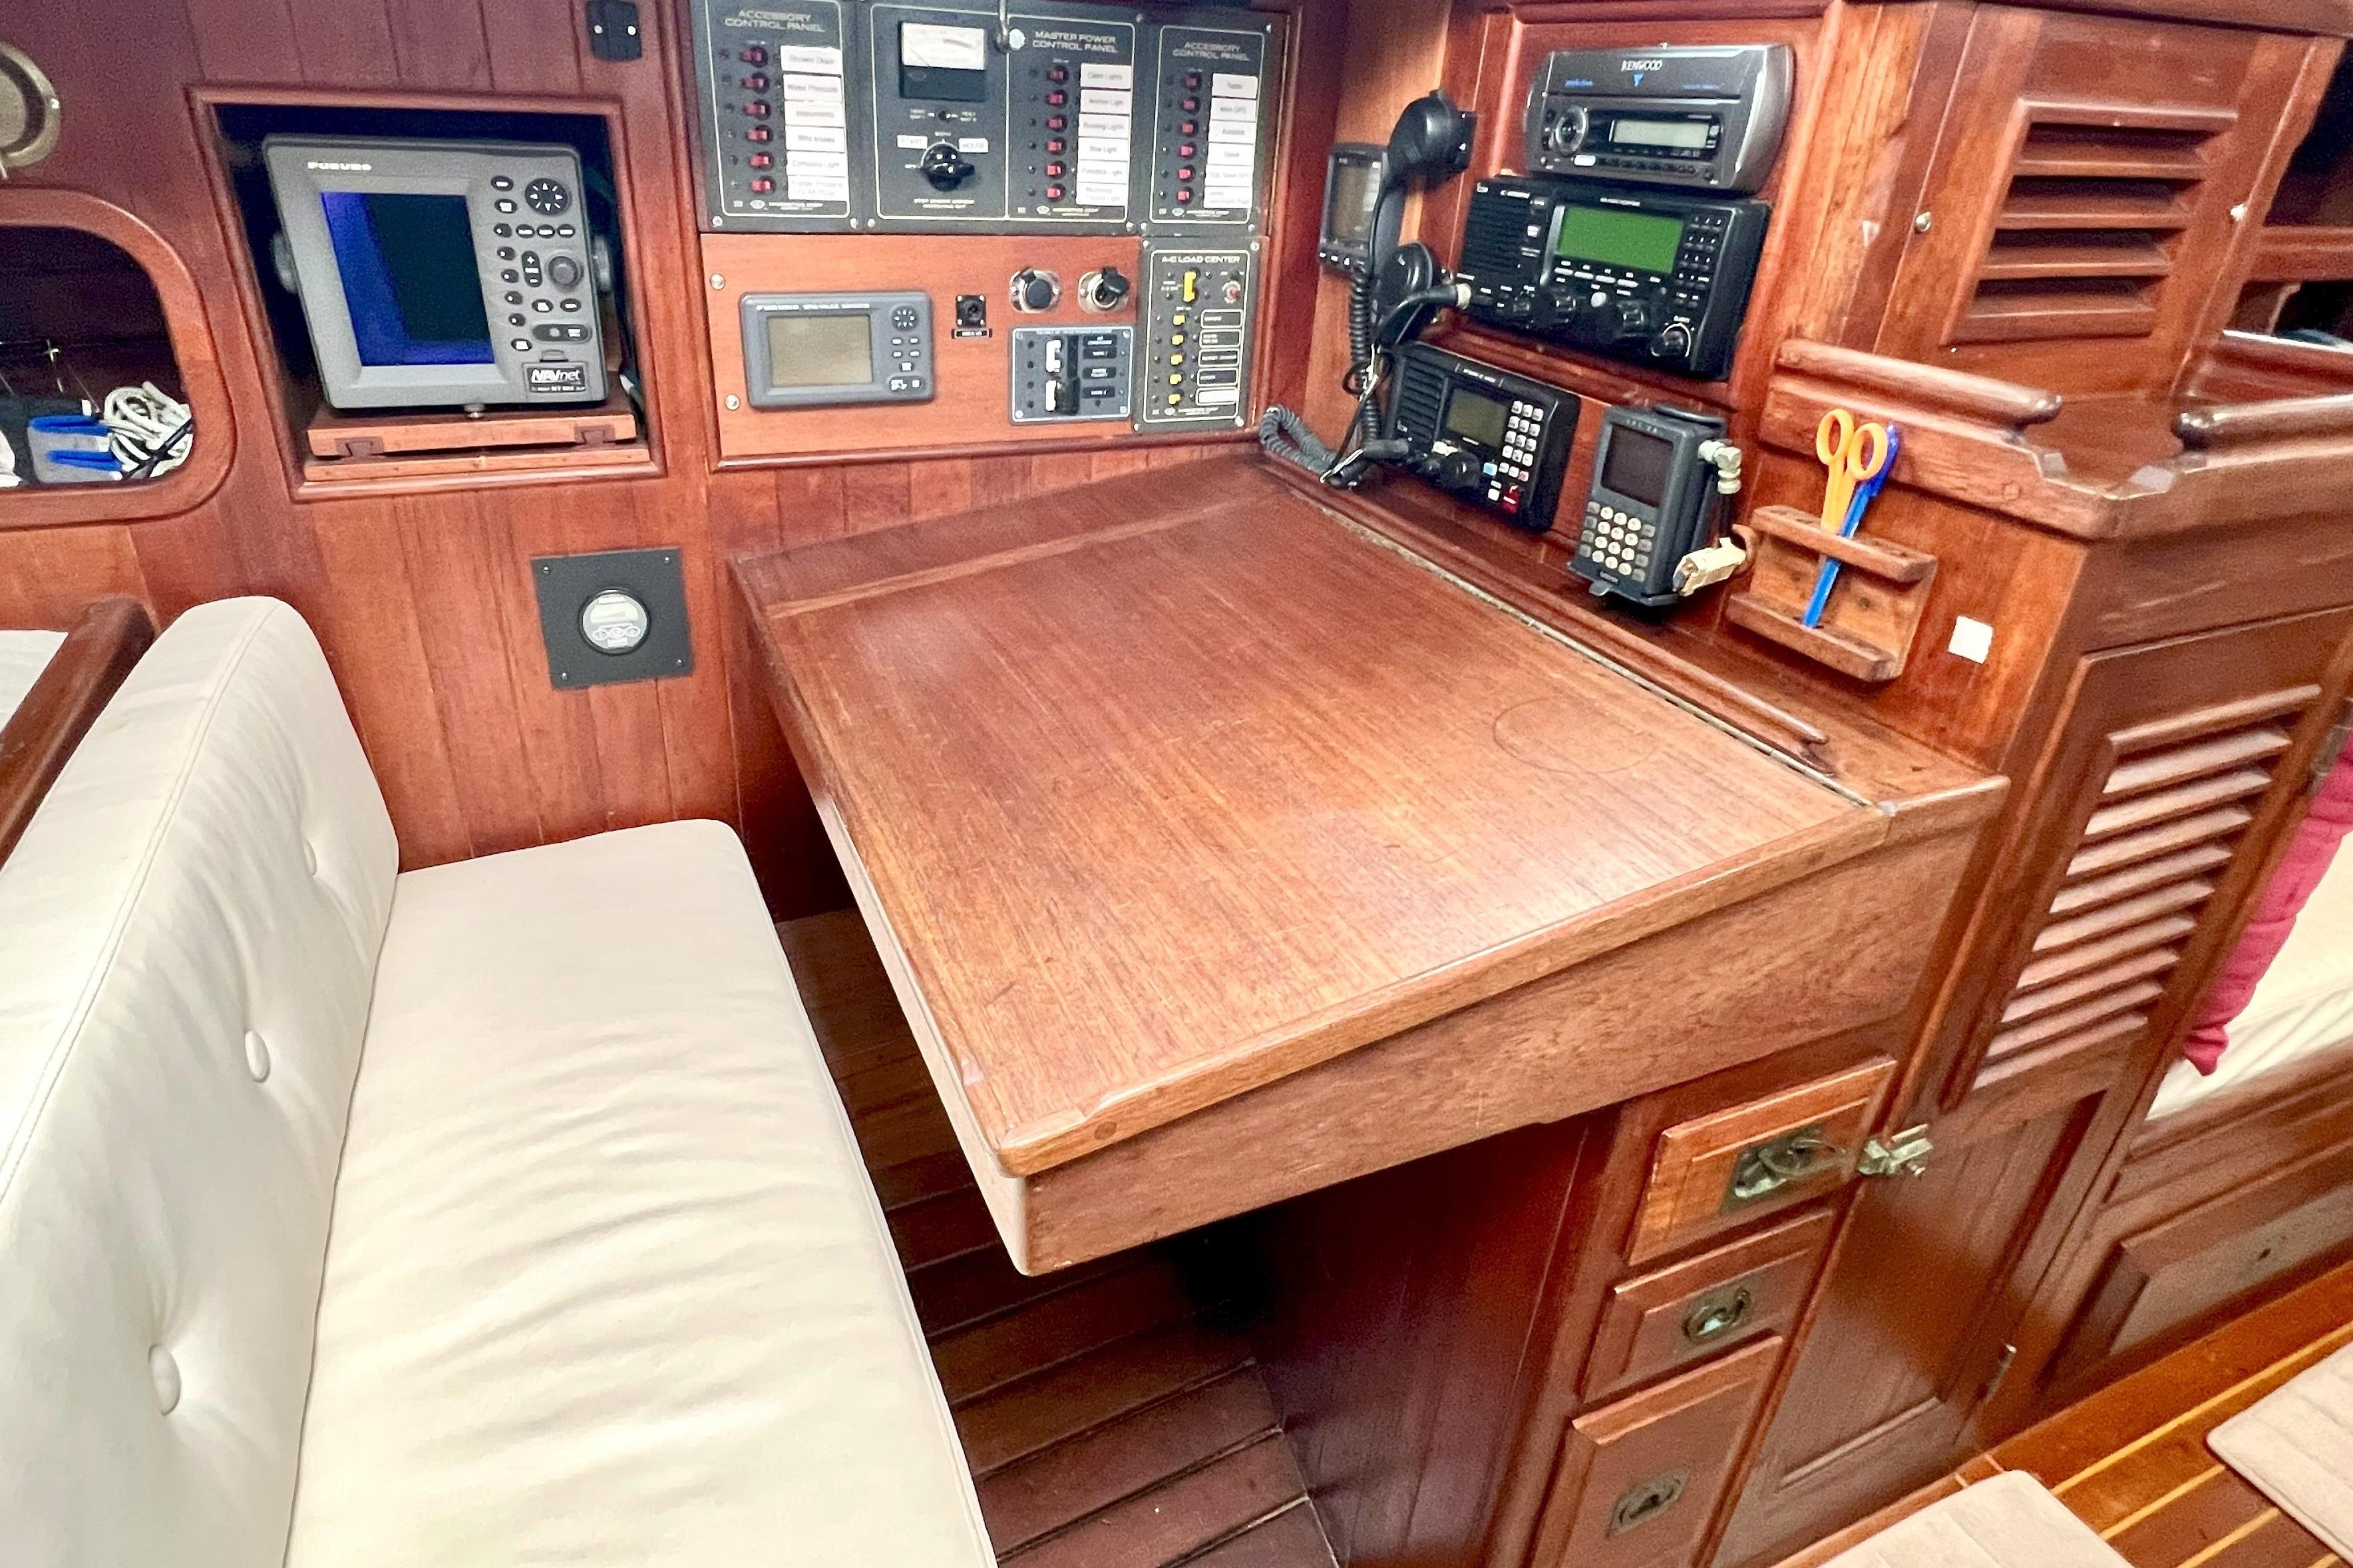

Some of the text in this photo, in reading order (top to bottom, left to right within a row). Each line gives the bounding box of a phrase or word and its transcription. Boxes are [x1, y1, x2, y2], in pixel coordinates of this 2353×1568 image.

[738, 10, 812, 22] ACCESSORY
[724, 18, 826, 33] CONTROL PANEL
[1034, 31, 1116, 44] MASTER POWER
[1032, 40, 1119, 53] CONTROL PANEL
[1183, 41, 1241, 53] ACCESSORY
[1173, 49, 1250, 61] CONTROL PANEL
[1621, 59, 1663, 71] KENWOOD
[307, 162, 371, 171] FURUNO
[530, 369, 580, 383] NAVnet
